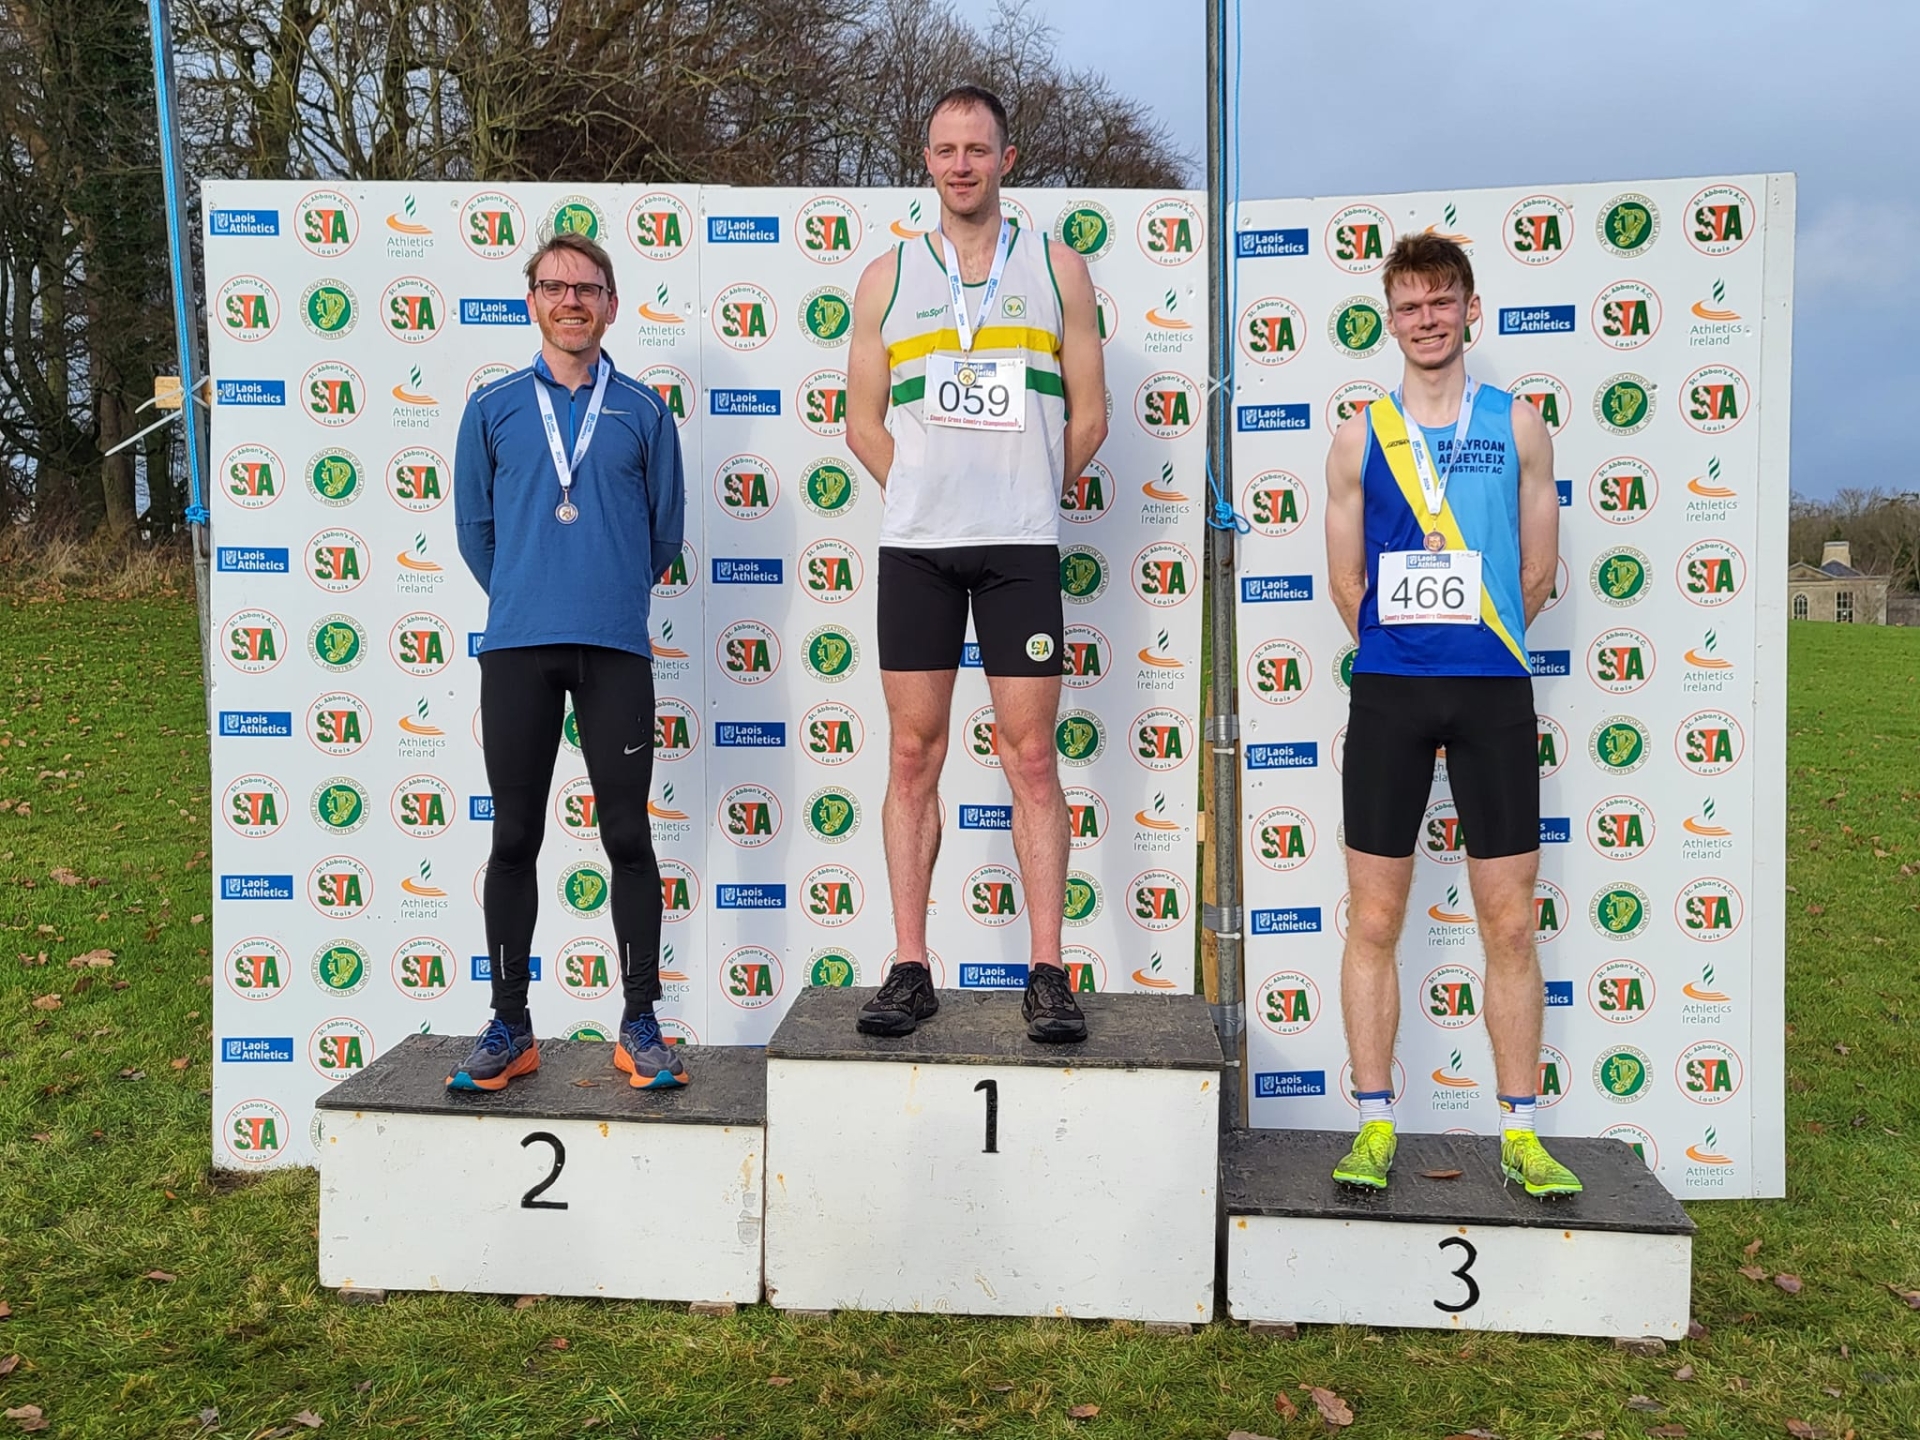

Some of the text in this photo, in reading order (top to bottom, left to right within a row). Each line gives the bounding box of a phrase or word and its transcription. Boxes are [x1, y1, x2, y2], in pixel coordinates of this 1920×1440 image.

[229, 213, 256, 222] Laois
[230, 221, 275, 233] Athletics
[305, 210, 349, 244] STA
[728, 220, 755, 229] Laois
[1696, 206, 1742, 242] STA
[638, 213, 682, 247] STA
[728, 228, 774, 240] Athletics
[806, 216, 851, 251] STA
[1516, 216, 1562, 252] STA
[1148, 219, 1192, 252] STA
[1256, 233, 1283, 243] Laois
[387, 236, 433, 247] Athletics
[1337, 225, 1382, 260] STA
[387, 248, 423, 258] Ireland
[1256, 243, 1304, 254] Athletics
[481, 302, 507, 312] Laois
[391, 296, 435, 330] STA
[481, 311, 526, 322] Athletics
[1521, 310, 1550, 320] Laois
[1604, 301, 1650, 336] STA
[638, 325, 685, 335] Athletics
[1521, 320, 1570, 330] Athletics
[1690, 323, 1742, 334] Athletics
[1145, 332, 1193, 341] Athletics
[1251, 318, 1295, 352] STA
[639, 335, 675, 346] Ireland
[1690, 335, 1730, 346] Ireland
[1145, 343, 1182, 352] Ireland
[236, 383, 262, 392] Laois
[236, 393, 281, 403] Athletics
[731, 393, 756, 402] Laois
[939, 381, 1010, 417] 059
[393, 407, 439, 417] Athletics
[731, 403, 776, 412] Athletics
[1258, 408, 1285, 418] Laois
[393, 418, 429, 428] Ireland
[1258, 418, 1305, 428] Athletics
[231, 463, 275, 496] STA
[1141, 503, 1189, 513] Athletics
[1686, 500, 1737, 510] Athletics
[1141, 514, 1179, 524] Ireland
[1687, 511, 1725, 521] Ireland
[238, 551, 265, 560] Laois
[1417, 554, 1437, 562] Laois
[238, 560, 284, 570] Athletics
[733, 563, 758, 572] Laois
[397, 573, 444, 583] Athletics
[733, 572, 777, 581] Athletics
[1688, 559, 1734, 594] STA
[397, 584, 433, 593] Ireland
[1262, 580, 1288, 589] Laois
[1262, 589, 1308, 599] Athletics
[1391, 576, 1465, 609] 466
[232, 628, 276, 661] STA
[1600, 648, 1644, 681] STA
[1137, 669, 1184, 679] Athletics
[1684, 671, 1734, 681] Athletics
[1137, 680, 1173, 690] Ireland
[1684, 682, 1722, 692] Ireland
[240, 715, 267, 724] Laois
[240, 725, 287, 734] Athletics
[736, 727, 761, 735] Laois
[399, 738, 445, 747] Athletics
[736, 735, 780, 744] Athletics
[811, 721, 853, 754] STA
[1138, 726, 1182, 759] STA
[399, 748, 435, 757] Ireland
[1268, 746, 1293, 755] Laois
[1267, 755, 1313, 765] Athletics
[402, 794, 445, 826] STA
[980, 808, 1005, 817] Laois
[979, 818, 1011, 827] Athlet
[1134, 832, 1181, 841] Athletics
[1599, 815, 1644, 848] STA
[1134, 842, 1170, 851] Ireland
[1683, 839, 1732, 848] Athletics
[1683, 849, 1721, 859] Ireland
[242, 879, 269, 888] Laois
[242, 886, 288, 897] Athletics
[737, 888, 762, 896] Laois
[401, 899, 448, 908] Athletics
[736, 895, 781, 905] Athletics
[1135, 888, 1179, 920] STA
[401, 909, 437, 918] Ireland
[1272, 912, 1297, 921] Laois
[1271, 920, 1317, 931] Athletics
[1428, 926, 1476, 936] Athletics
[1428, 936, 1465, 946] Ireland
[980, 967, 1005, 976] Laois
[732, 964, 772, 997] STA
[980, 976, 1023, 985] Athletics
[1433, 984, 1475, 1016] STA
[1268, 990, 1310, 1023] STA
[1682, 1004, 1731, 1013] Athletics
[1683, 1014, 1720, 1023] Ireland
[243, 1041, 269, 1050] Laois
[242, 1050, 288, 1059] Athletics
[320, 1036, 363, 1069] STA
[1276, 1075, 1301, 1084] Laois
[1688, 1060, 1732, 1092] STA
[1276, 1085, 1320, 1093] Athletics
[1432, 1090, 1479, 1099] Athletics
[1433, 1100, 1469, 1110] Ireland
[974, 1079, 999, 1153] 1
[236, 1118, 278, 1150] STA
[520, 1131, 568, 1209] 2
[1686, 1167, 1734, 1176] Athletics
[1686, 1177, 1723, 1186] Ireland
[1433, 1236, 1480, 1312] 3
